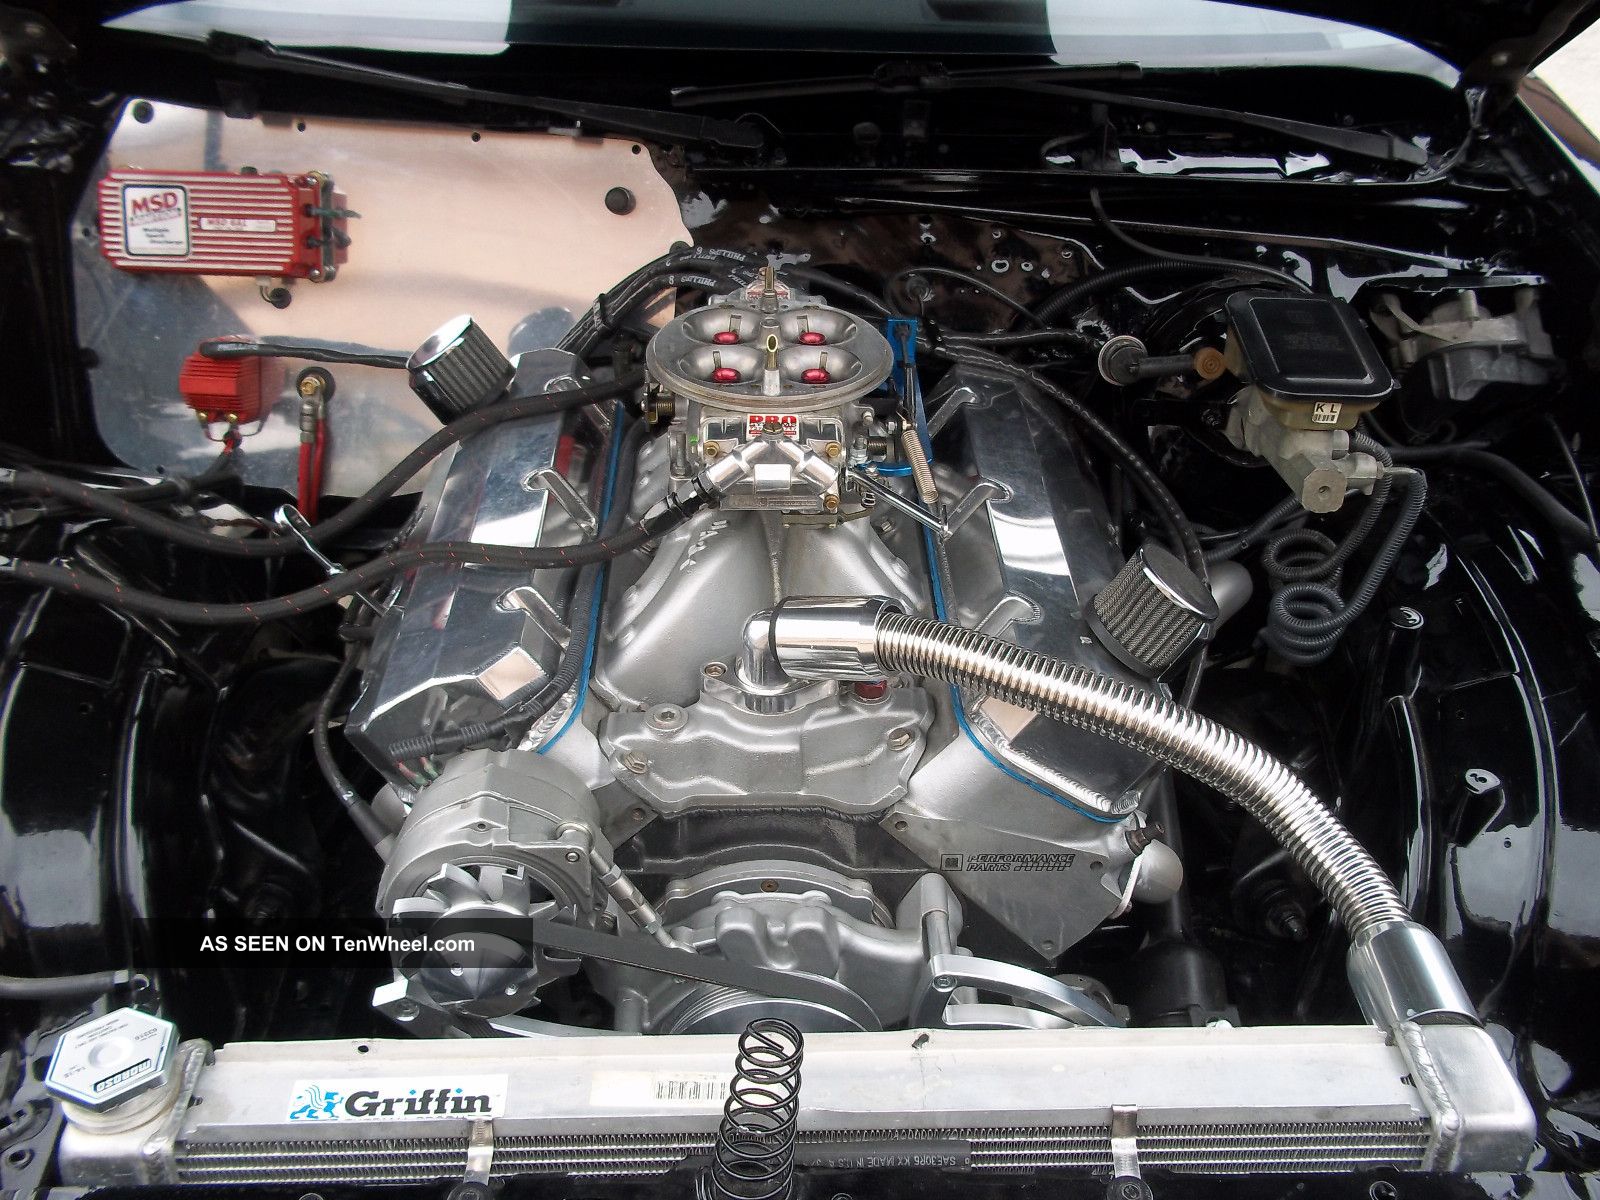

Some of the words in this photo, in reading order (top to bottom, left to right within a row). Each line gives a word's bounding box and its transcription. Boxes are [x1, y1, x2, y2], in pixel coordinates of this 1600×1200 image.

[131, 192, 178, 214] MSD
[1315, 403, 1324, 413] K
[1330, 403, 1338, 413] L
[967, 853, 1076, 863] PERFORMANCE
[966, 862, 1011, 872] PARTS
[344, 1088, 493, 1117] Griffin
[867, 1156, 896, 1167] MADE
[914, 1155, 957, 1166] SAE30R6
